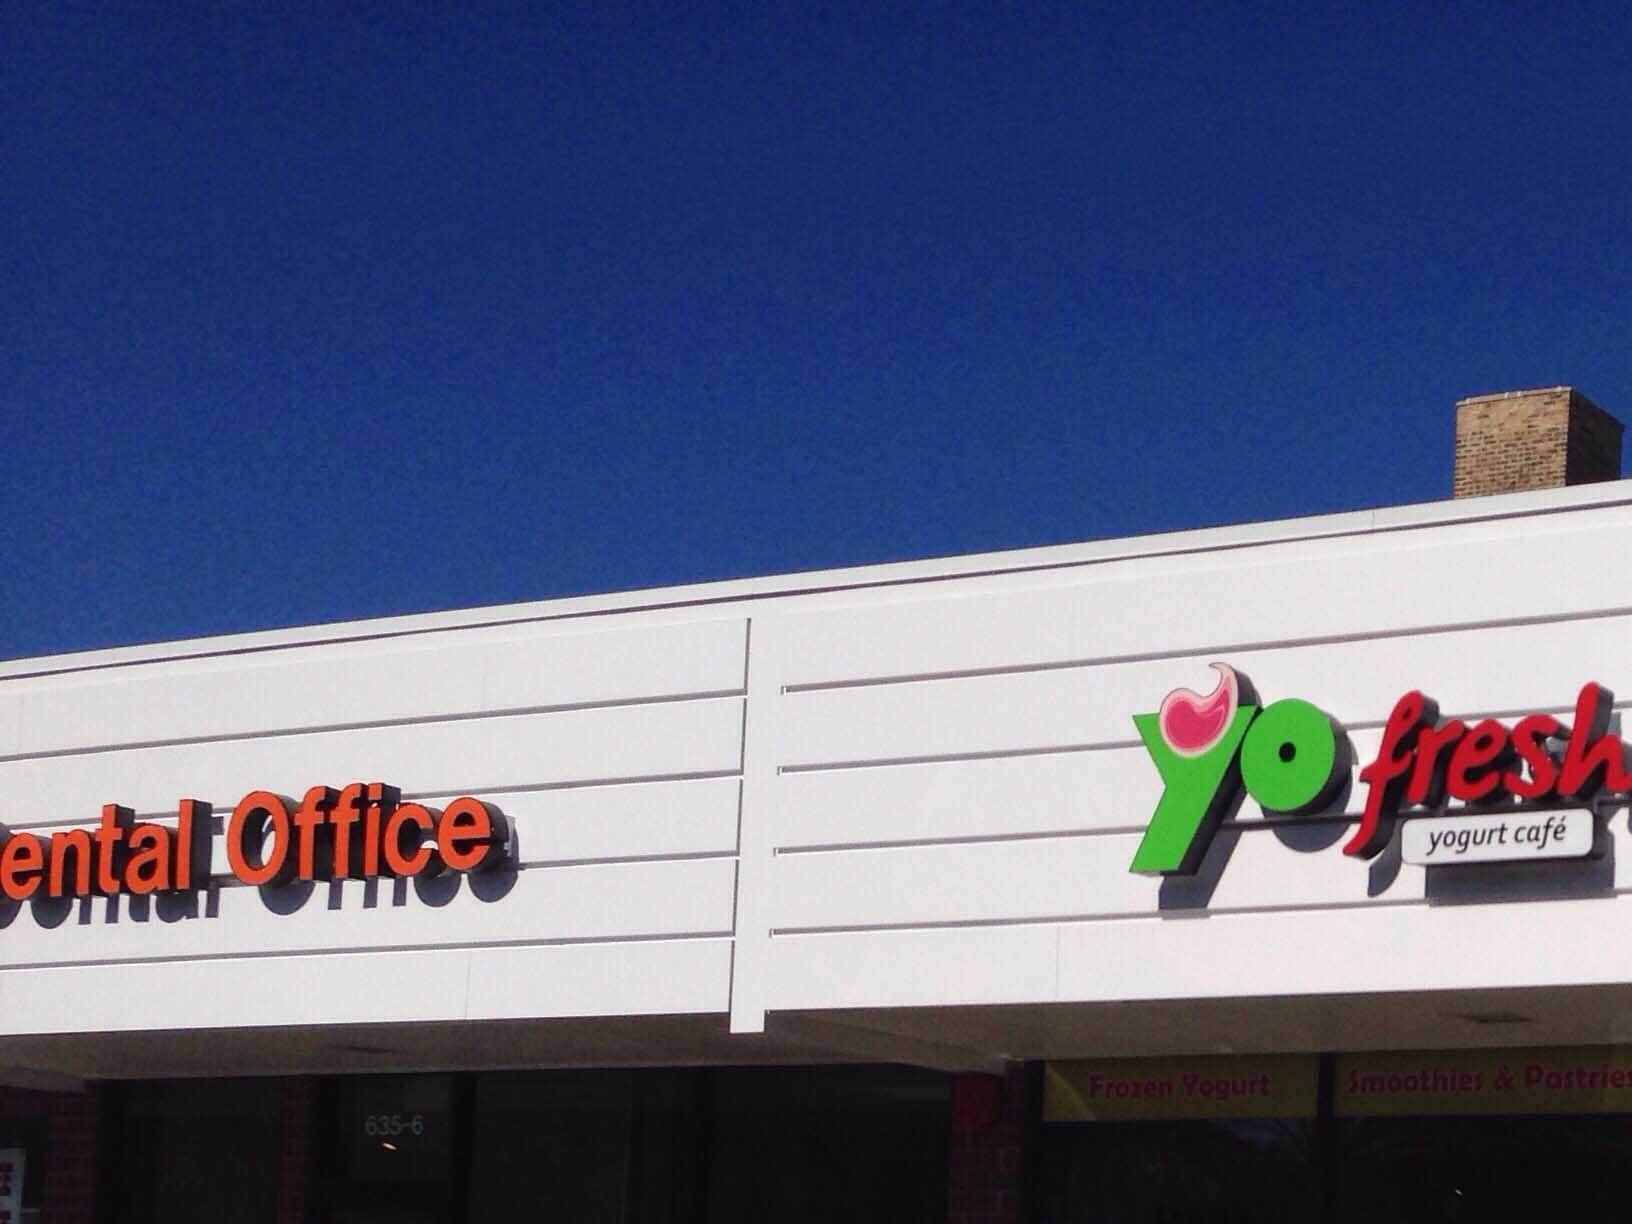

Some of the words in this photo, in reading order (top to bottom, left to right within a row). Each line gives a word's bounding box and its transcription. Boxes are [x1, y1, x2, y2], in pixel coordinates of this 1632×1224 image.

[227, 782, 492, 886] Office
[1426, 824, 1508, 856] yogurt
[1514, 815, 1566, 850] café
[1089, 1072, 1172, 1098] Frozen
[1183, 1072, 1269, 1101] Yogurt
[1346, 1069, 1482, 1094] Smoothies
[1495, 1066, 1514, 1091] &
[365, 1114, 424, 1136] 635-6
